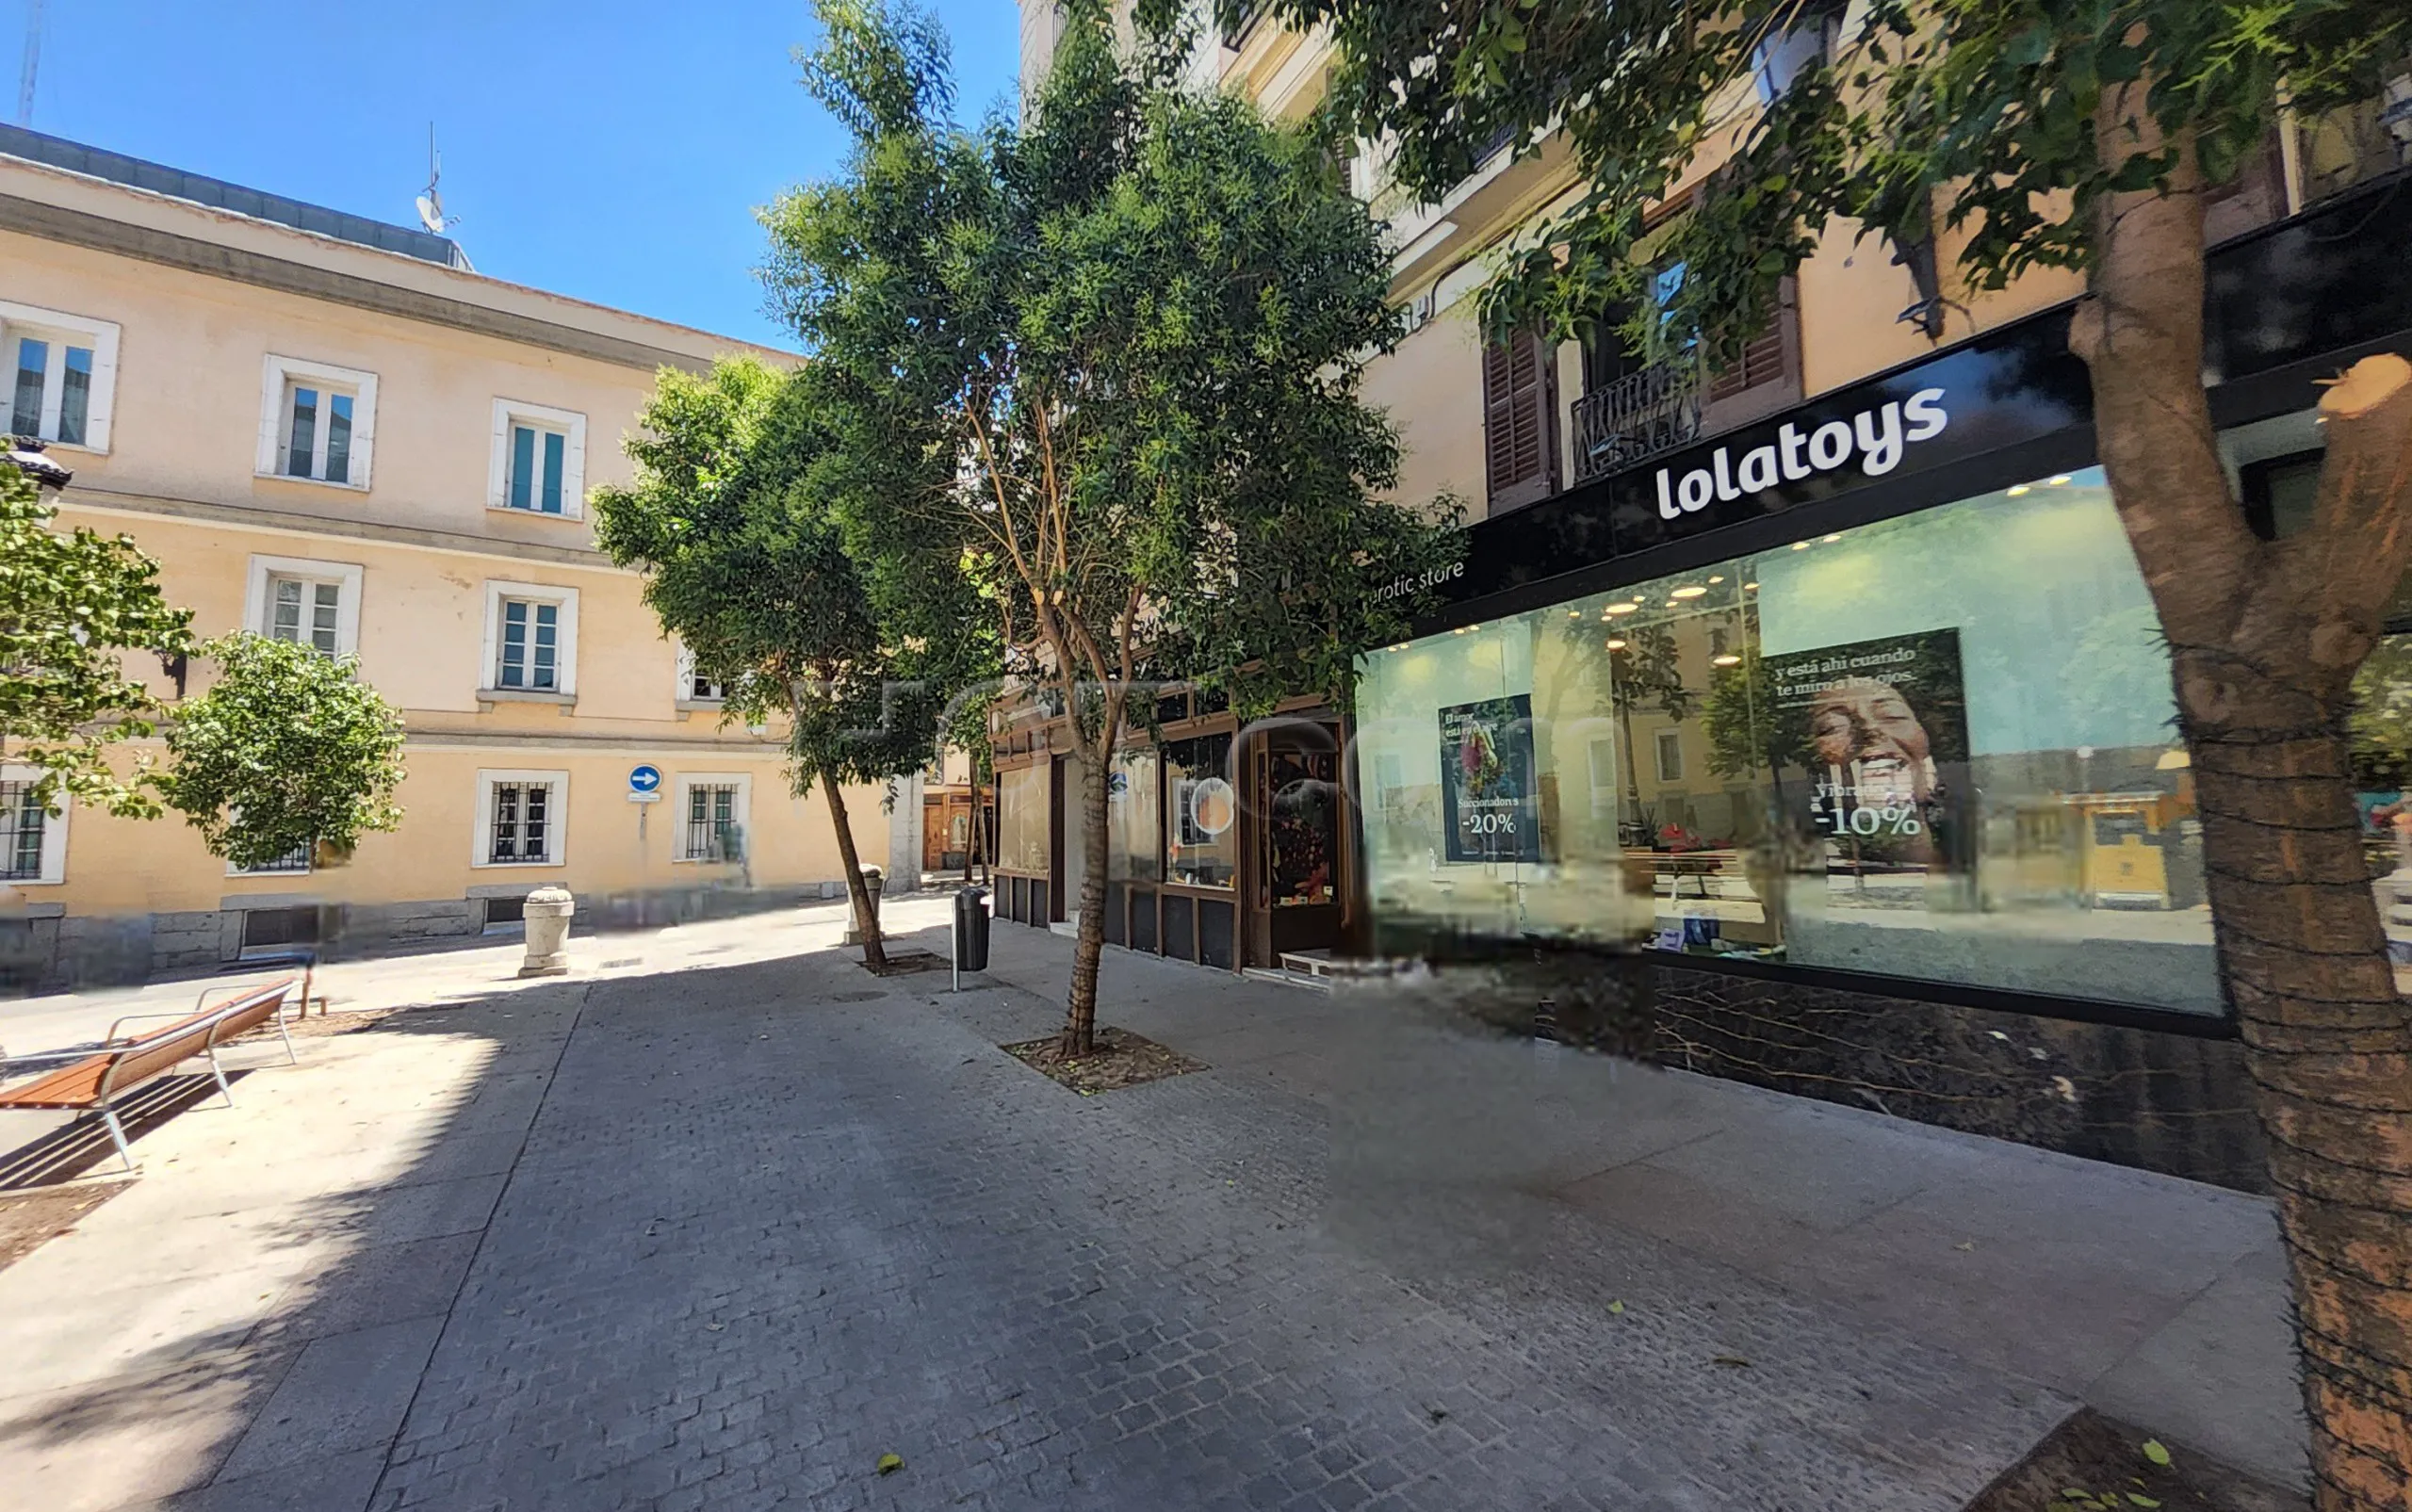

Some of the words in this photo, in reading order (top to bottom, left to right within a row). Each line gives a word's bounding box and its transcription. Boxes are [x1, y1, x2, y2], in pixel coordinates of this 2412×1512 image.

[1656, 388, 1948, 519] lolatoys
[1418, 561, 1465, 590] store
[1786, 659, 1819, 676] está
[1850, 647, 1916, 668] cuando
[1776, 684, 1793, 697] te
[1458, 795, 1519, 808] Succionadors
[1462, 813, 1517, 834] -20%
[1815, 806, 1921, 836] -10%
